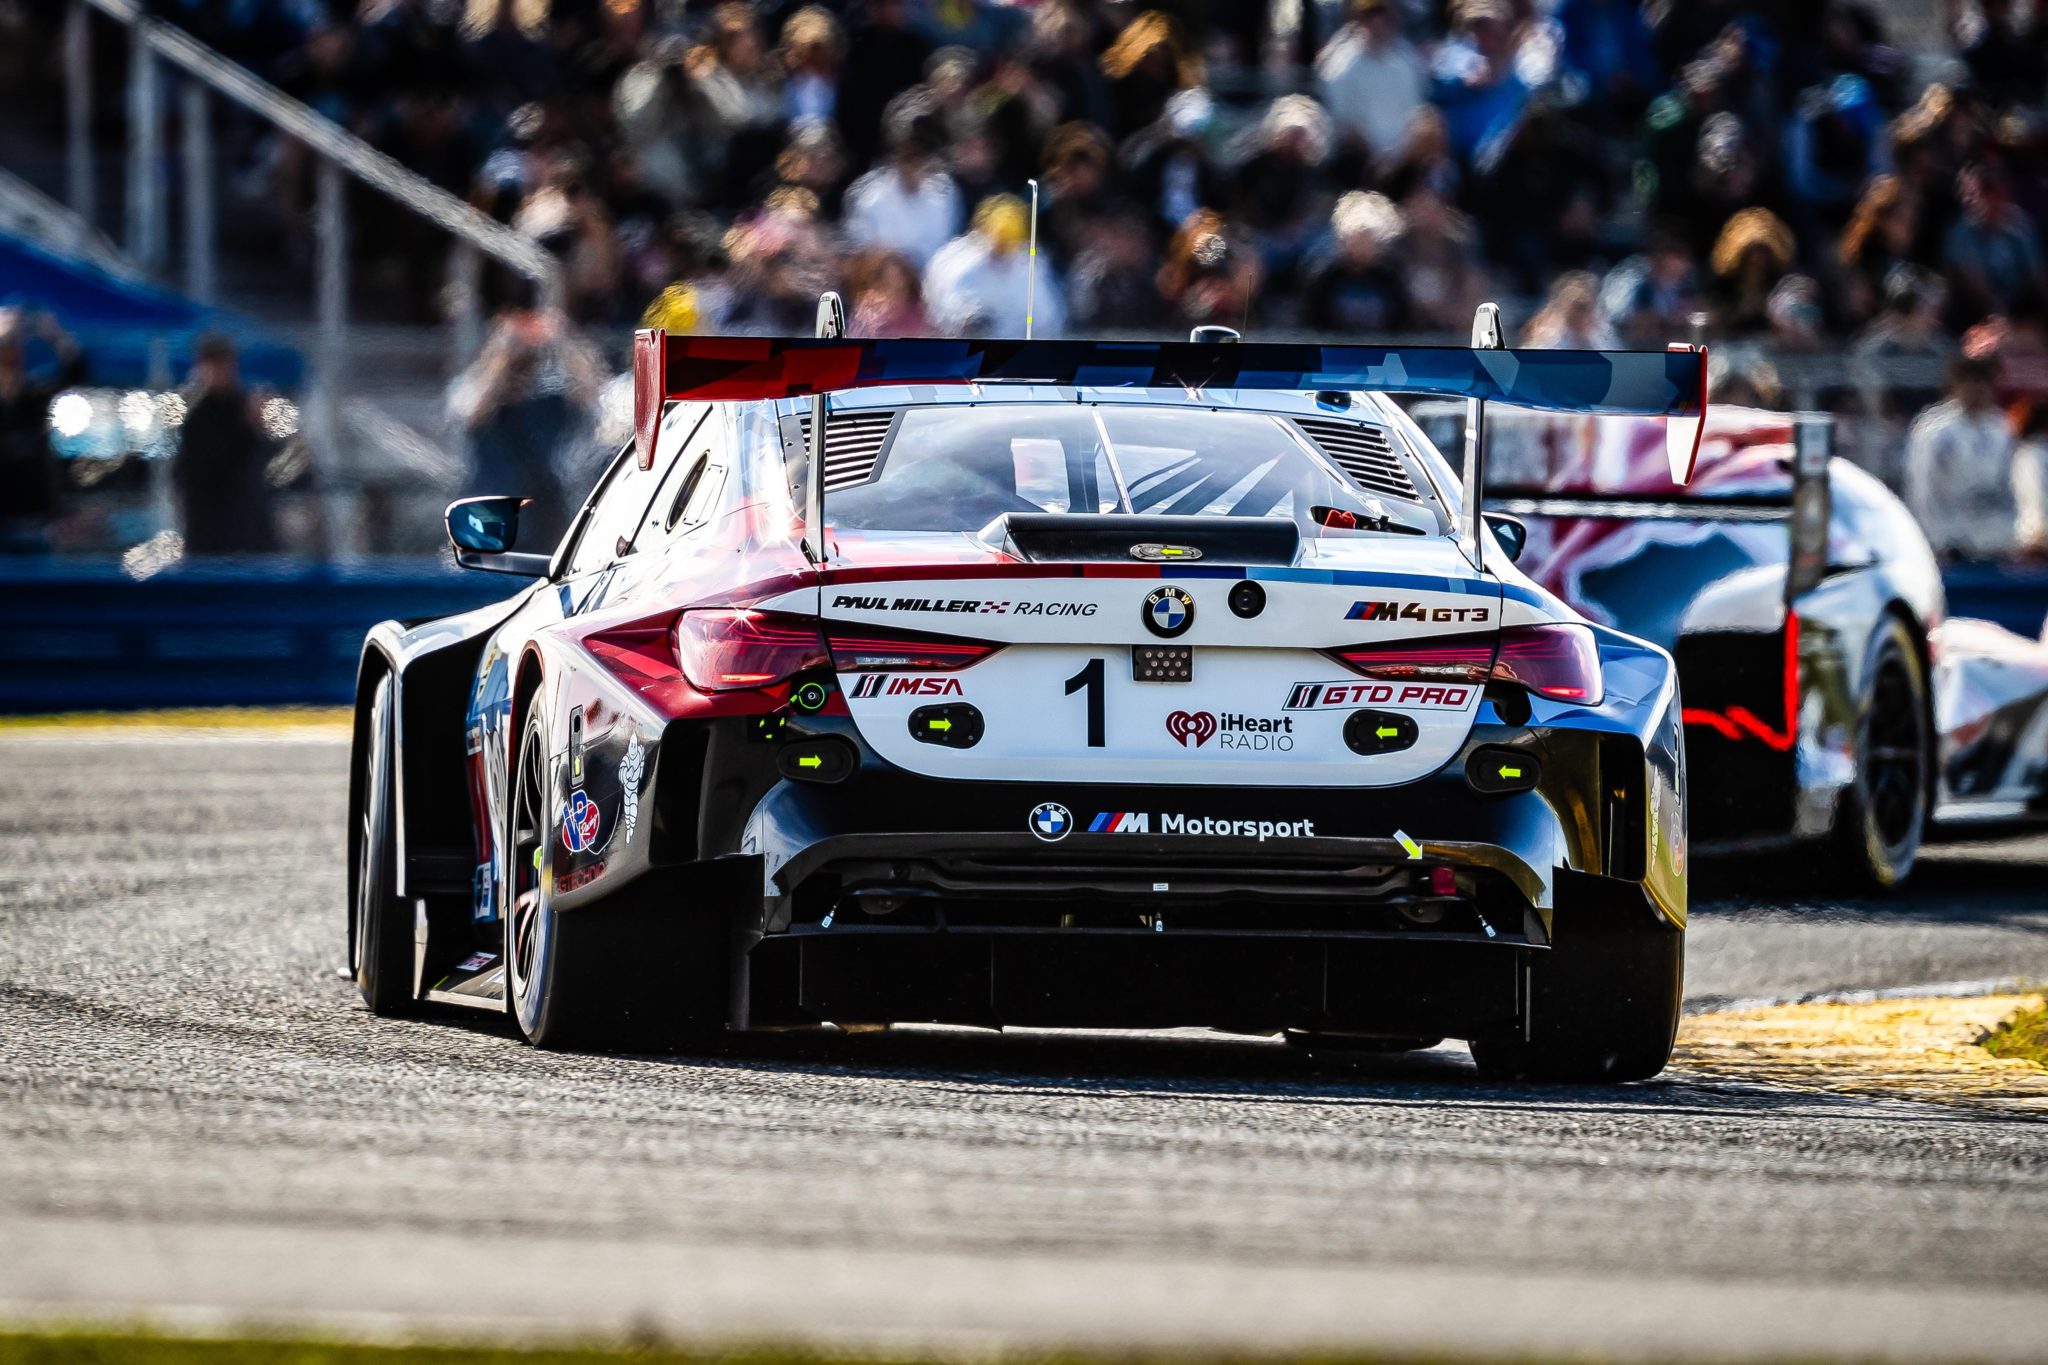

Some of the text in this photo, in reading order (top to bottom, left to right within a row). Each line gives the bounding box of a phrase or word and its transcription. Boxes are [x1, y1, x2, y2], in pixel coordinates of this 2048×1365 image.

[832, 595, 1098, 617] PAUL MILLER RACING
[1148, 588, 1192, 606] BMW
[1370, 601, 1490, 622] M4 GT3
[885, 677, 964, 697] IMSA
[1322, 686, 1469, 706] GTD PRO
[1064, 658, 1106, 748] 1
[1220, 712, 1293, 733] iHeart
[1220, 734, 1294, 752] RADIO
[1161, 813, 1315, 841] Motorsport
